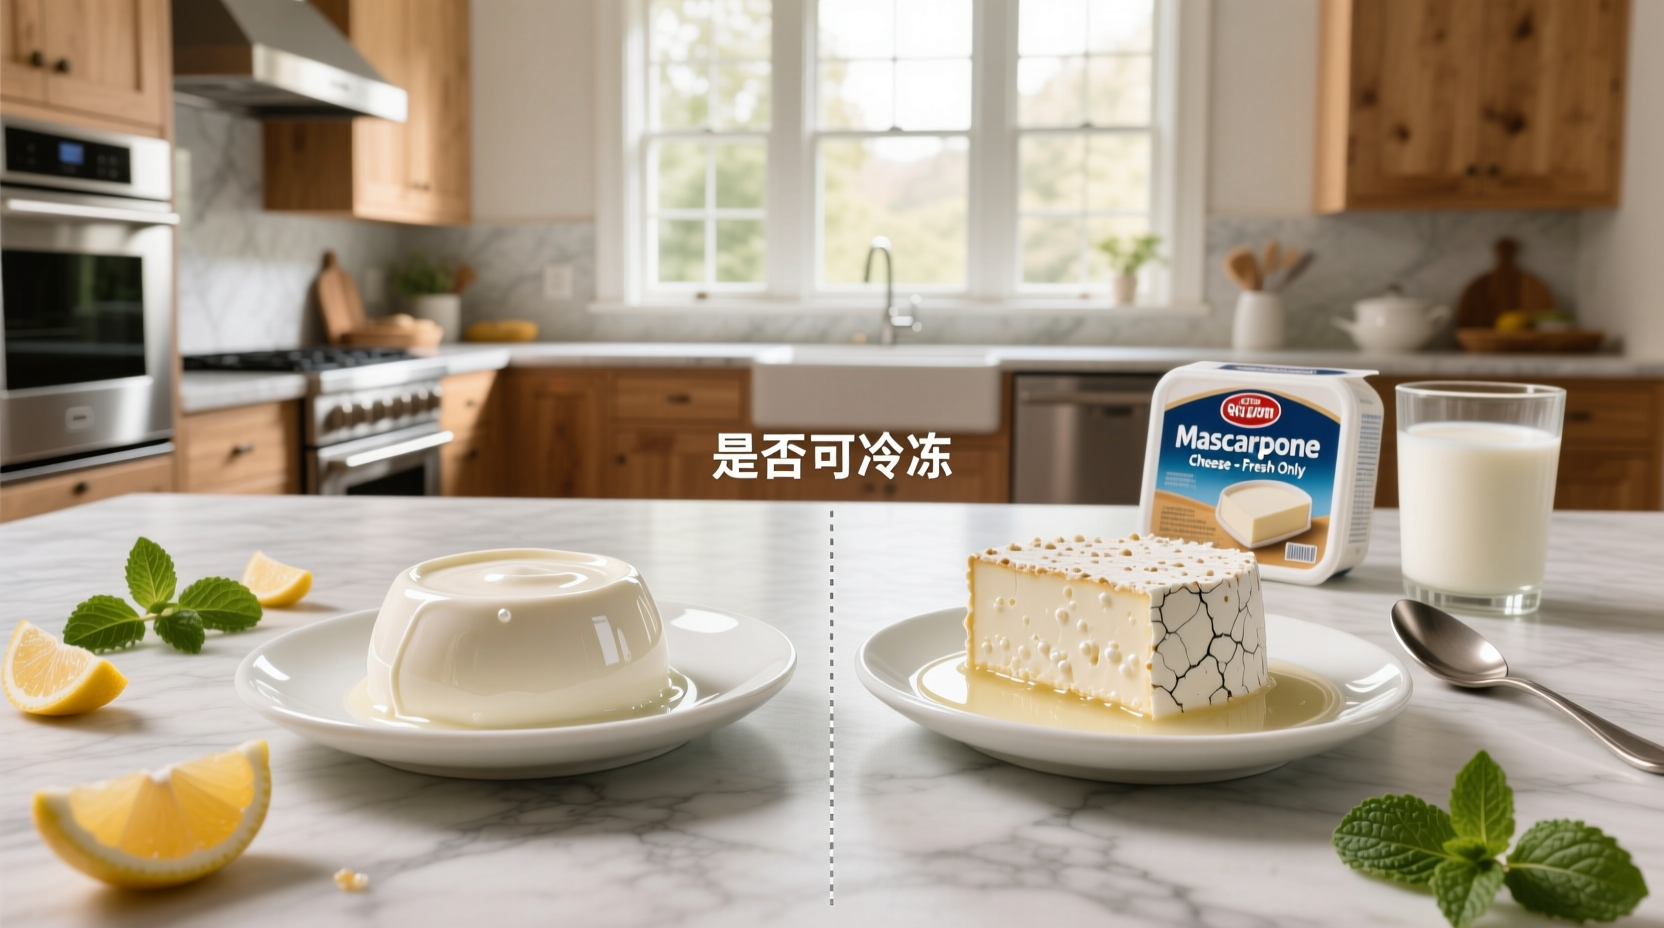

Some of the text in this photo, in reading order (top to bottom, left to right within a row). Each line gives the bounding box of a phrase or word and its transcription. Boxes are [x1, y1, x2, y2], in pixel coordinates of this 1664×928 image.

[1175, 424, 1320, 459] Mascarpone
[1188, 454, 1231, 470] Cheese
[1241, 458, 1275, 474] Fresh
[1277, 461, 1306, 479] Only
